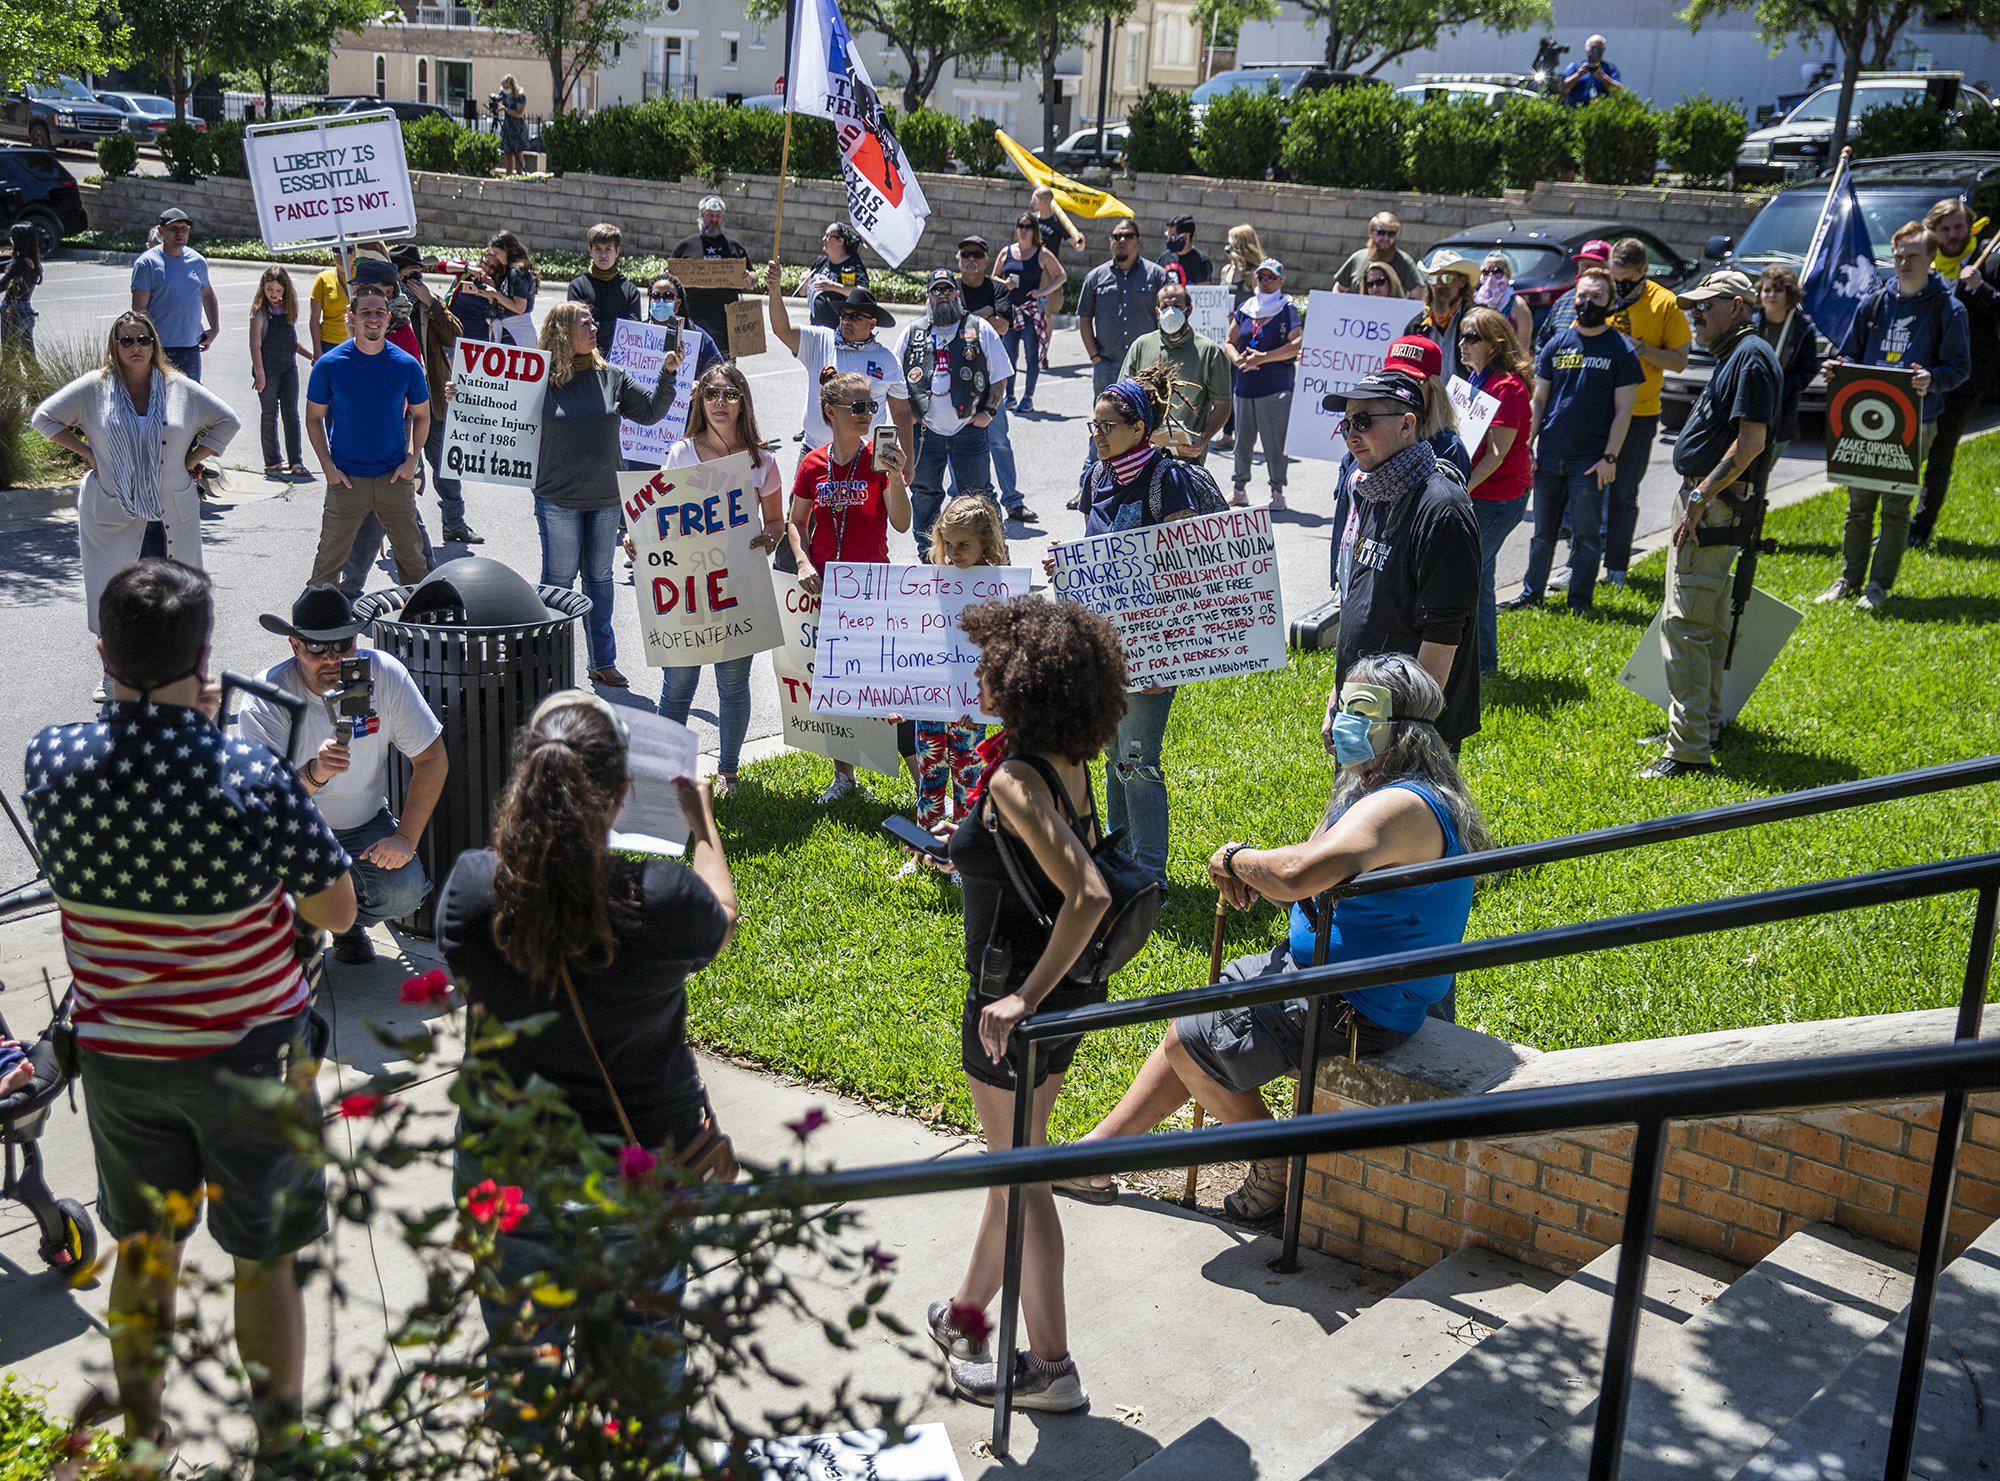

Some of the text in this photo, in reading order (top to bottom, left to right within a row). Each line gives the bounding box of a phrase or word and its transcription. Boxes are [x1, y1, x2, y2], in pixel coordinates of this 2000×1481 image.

[273, 144, 375, 173] LIBERTY IS
[280, 167, 380, 194] ESSENTIAL.
[275, 191, 396, 222] PANIC IS NOT.
[1333, 317, 1392, 341] JOBS
[460, 342, 545, 383] VOID
[1301, 347, 1386, 374] ESSENTIA
[457, 374, 509, 391] National
[455, 392, 517, 411] Childhood
[453, 410, 538, 435] Vaccine Injury
[450, 429, 516, 447] Act of 1986
[1838, 437, 1909, 458] MAKE ORWELL
[447, 446, 532, 479] Qui tam
[1831, 450, 1914, 471] FICTION AGAIN
[625, 471, 676, 523] LIVE
[656, 489, 749, 541] FREE
[1048, 509, 1269, 567] THE FIRST AMENDMENT
[648, 550, 678, 567] OR
[1054, 536, 1275, 591] CONGRESS SHALL MAKE NO LAW
[900, 565, 964, 597] Gates
[972, 581, 1009, 598] can
[1132, 577, 1151, 594] AN
[1152, 561, 1247, 590] ESTABLISHMENT
[1252, 557, 1273, 575] OF
[652, 568, 739, 615] DIE
[1086, 577, 1253, 615] GION OR PROHIBITING THE FREE
[1193, 594, 1250, 610] ABRIDGING
[1250, 590, 1275, 602] THE
[886, 609, 909, 631] his
[921, 610, 963, 633] pois
[1126, 636, 1138, 647] OF
[1140, 632, 1160, 643] THE
[1202, 616, 1256, 634] PEACEABLY
[1258, 615, 1276, 625] TO
[1128, 620, 1163, 634] SPEECH
[1167, 617, 1181, 627] OR
[1183, 615, 1195, 625] OF
[1195, 609, 1219, 621] THE
[1221, 605, 1253, 618] PRESS
[1260, 603, 1277, 615] OR
[648, 618, 753, 649] #OPENTEXAS
[1147, 644, 1163, 653] TO
[1165, 636, 1213, 652] PETITION
[1217, 630, 1247, 643] THE
[822, 636, 860, 678] I'm
[881, 635, 982, 673] Homeschoo
[1149, 657, 1170, 670] FOR
[1172, 655, 1181, 666] A
[1183, 646, 1230, 663] REDRESS
[1235, 645, 1249, 655] OF
[1129, 658, 1269, 688] OTECT THE FIRST AMENDMENT
[817, 687, 851, 710] NO
[858, 685, 951, 710] MANDATORY
[957, 682, 979, 707] Vac
[791, 715, 855, 739] #OPENTEXAS
